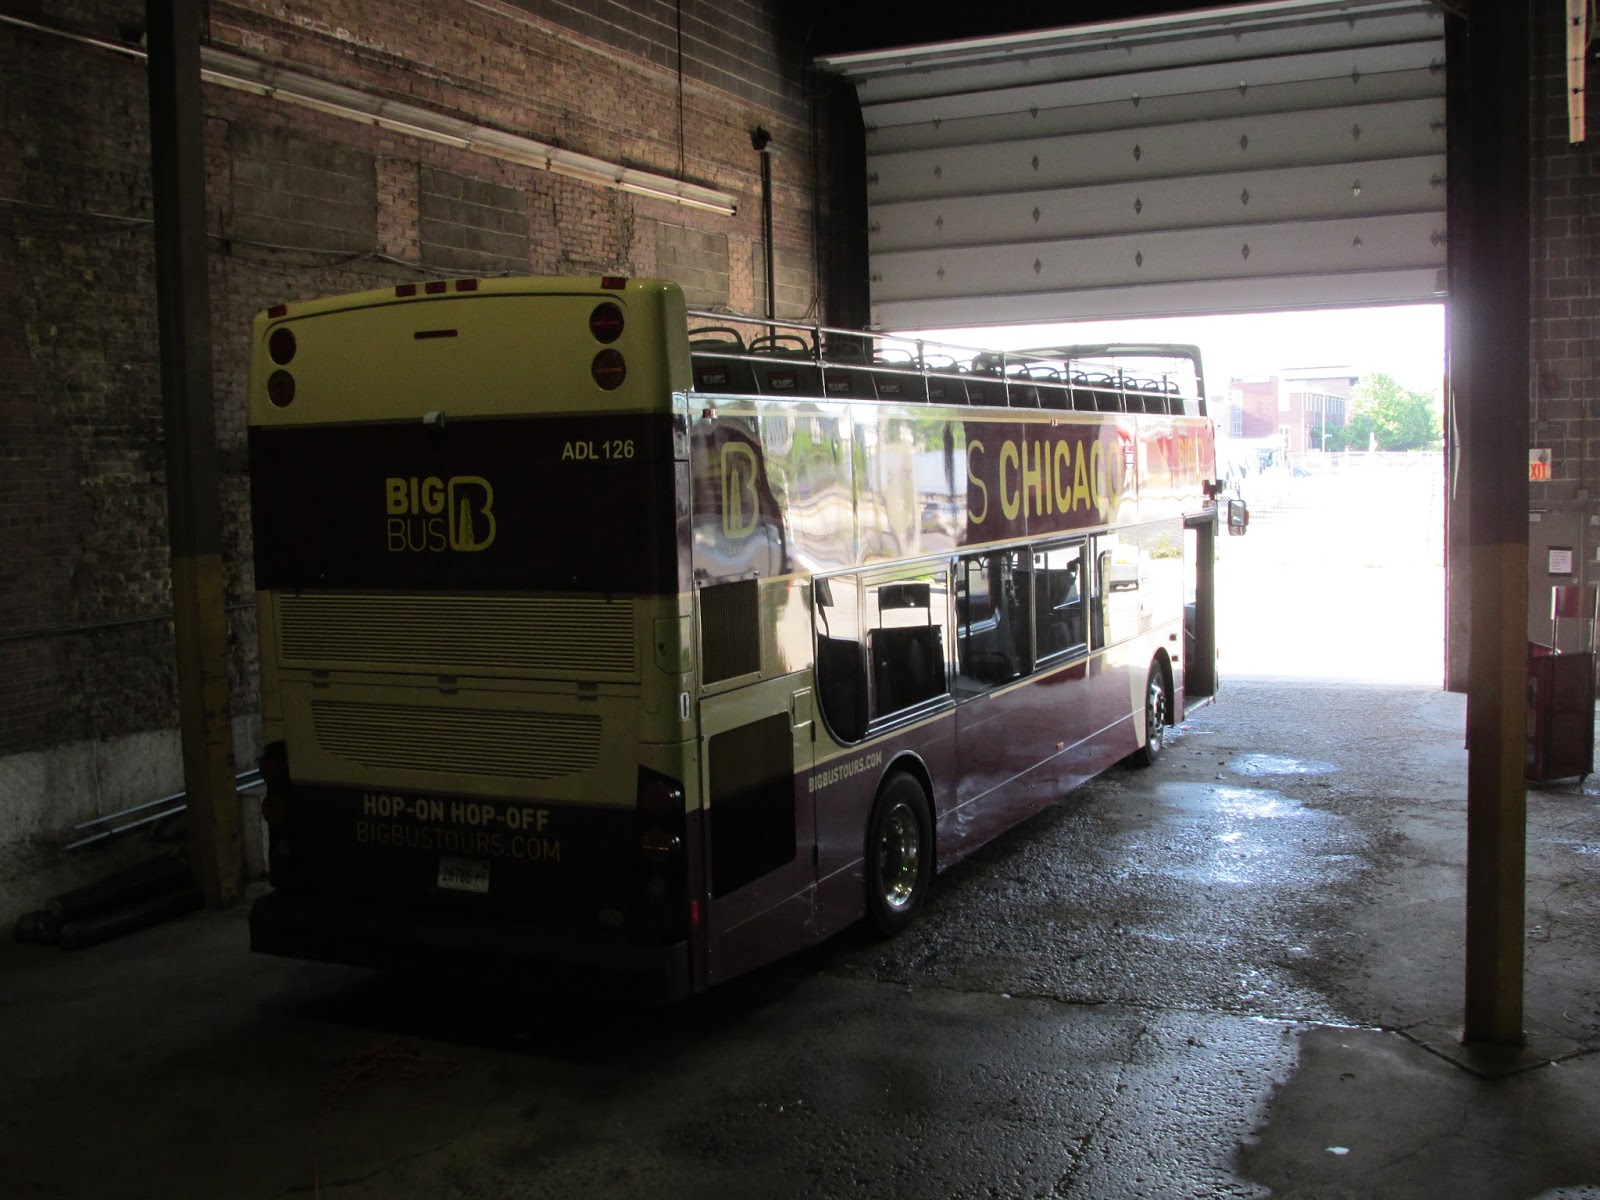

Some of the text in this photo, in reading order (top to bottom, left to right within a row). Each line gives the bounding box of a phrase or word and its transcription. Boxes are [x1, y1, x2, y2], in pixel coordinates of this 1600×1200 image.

[562, 440, 635, 460] ADL 126
[998, 439, 1123, 522] CHICAGO
[1530, 463, 1547, 479] XIT
[385, 475, 446, 515] BIG
[386, 517, 447, 553] BUS
[809, 751, 882, 793] BIGBUSTOURS.COM
[363, 794, 549, 831] HOP-ON HOP-OFF
[355, 820, 561, 862] BIGBUSTOURS.COM
